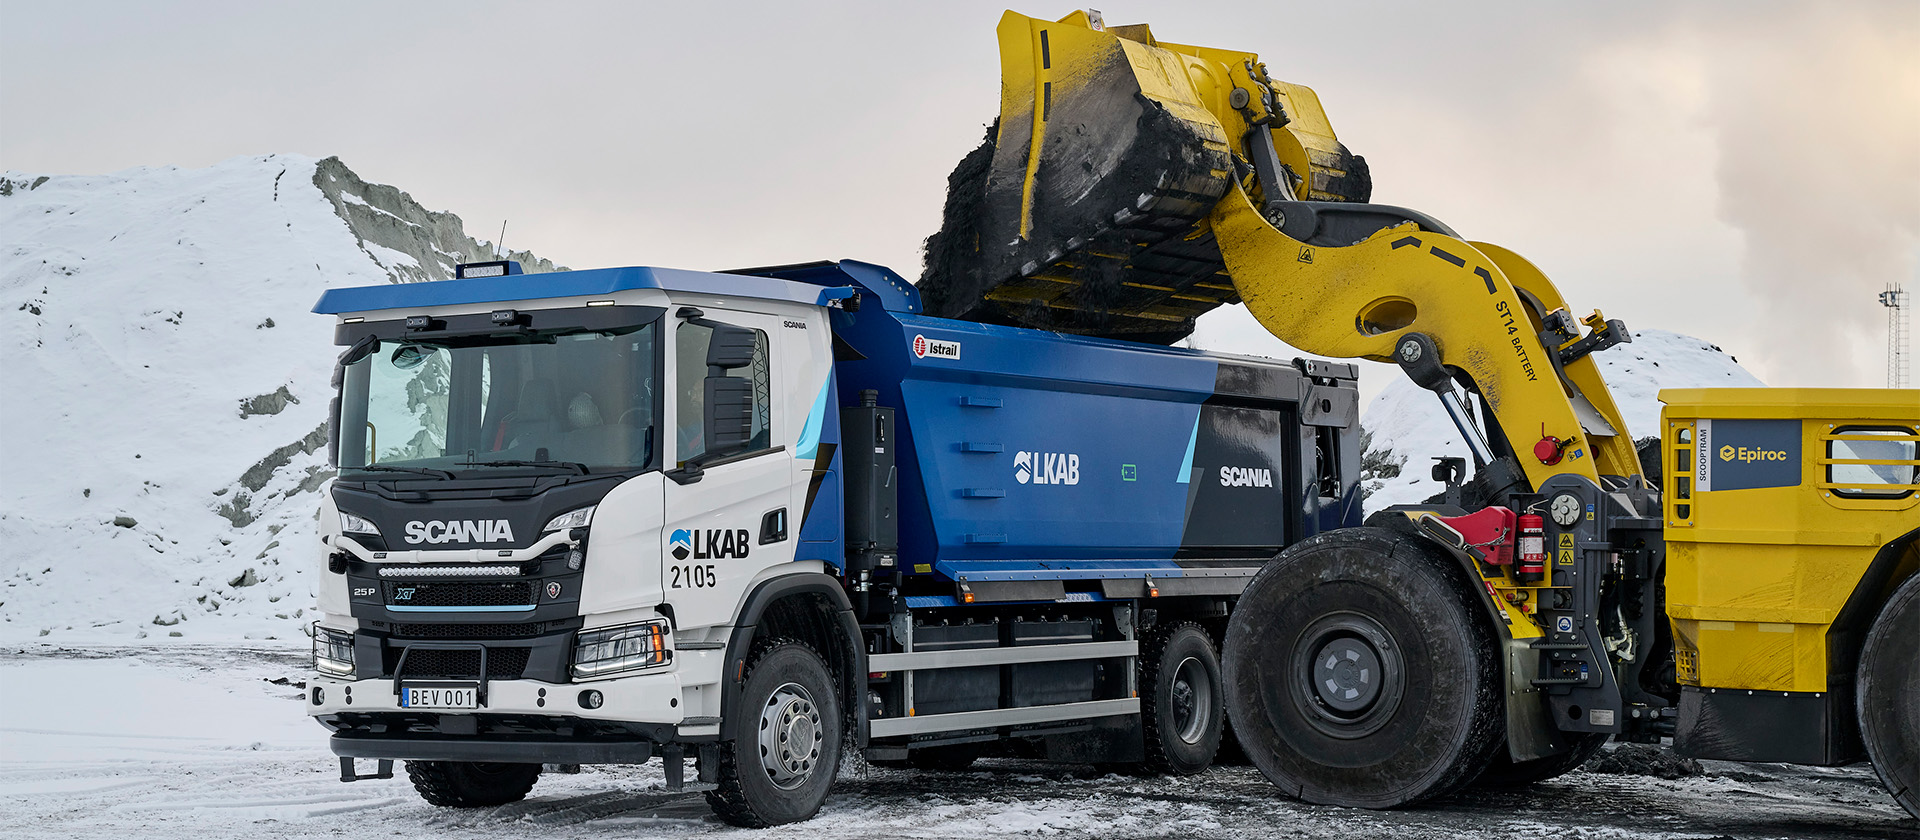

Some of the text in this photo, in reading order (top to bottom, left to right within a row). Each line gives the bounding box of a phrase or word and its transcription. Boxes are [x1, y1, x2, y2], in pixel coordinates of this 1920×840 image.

[783, 320, 807, 330] SCANIA
[929, 342, 957, 356] Istrail
[1496, 300, 1537, 382] ST14 BATTERY
[1699, 429, 1707, 482] SCOOPTRAM
[1738, 447, 1787, 463] Epiroc
[1033, 452, 1080, 485] LKAB
[1220, 466, 1273, 488] SCANIA
[404, 519, 515, 544] SCANIA
[694, 529, 749, 559] LKAB
[670, 565, 716, 588] 2105
[394, 587, 416, 600] XT
[411, 690, 472, 706] BEV 001
